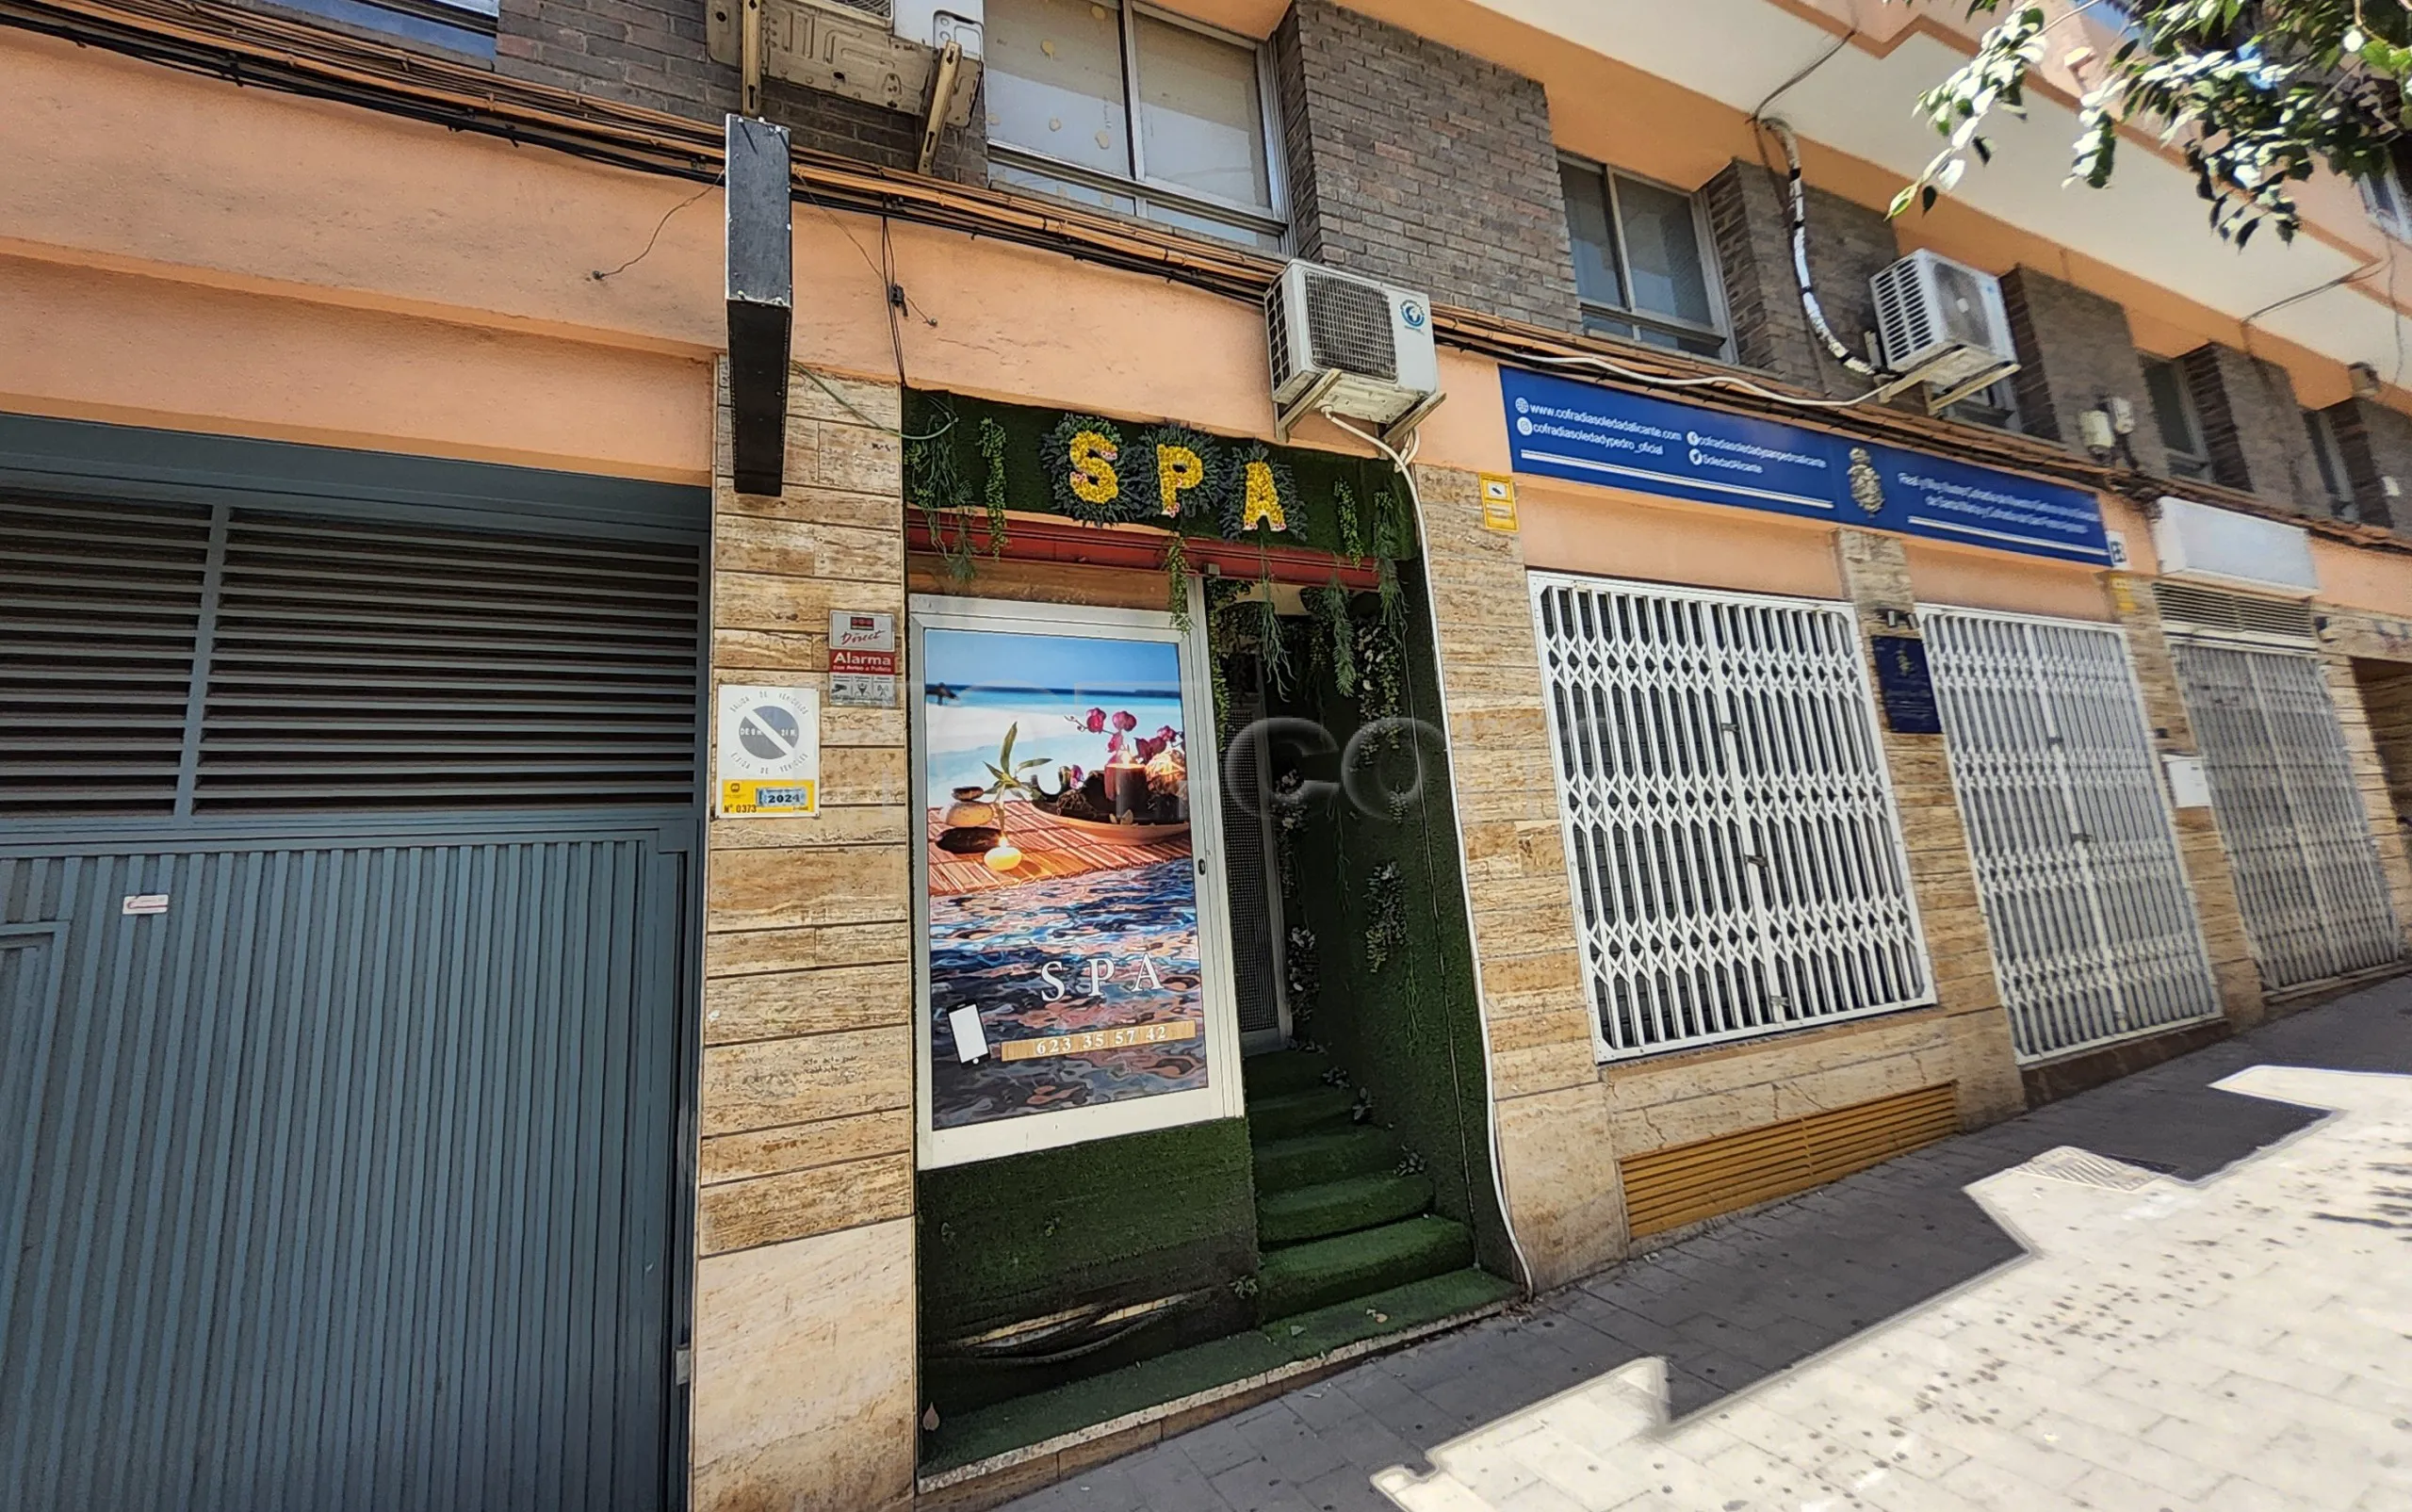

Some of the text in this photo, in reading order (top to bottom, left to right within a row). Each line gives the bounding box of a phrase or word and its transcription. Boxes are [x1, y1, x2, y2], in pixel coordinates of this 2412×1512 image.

[1068, 431, 1287, 532] SPA
[840, 629, 886, 645] Direct
[833, 651, 892, 666] Alarma
[767, 793, 801, 804] 2024
[736, 804, 758, 814] 0373
[1040, 952, 1165, 1002] SPA
[1035, 1025, 1167, 1055] 623 35 57 42
